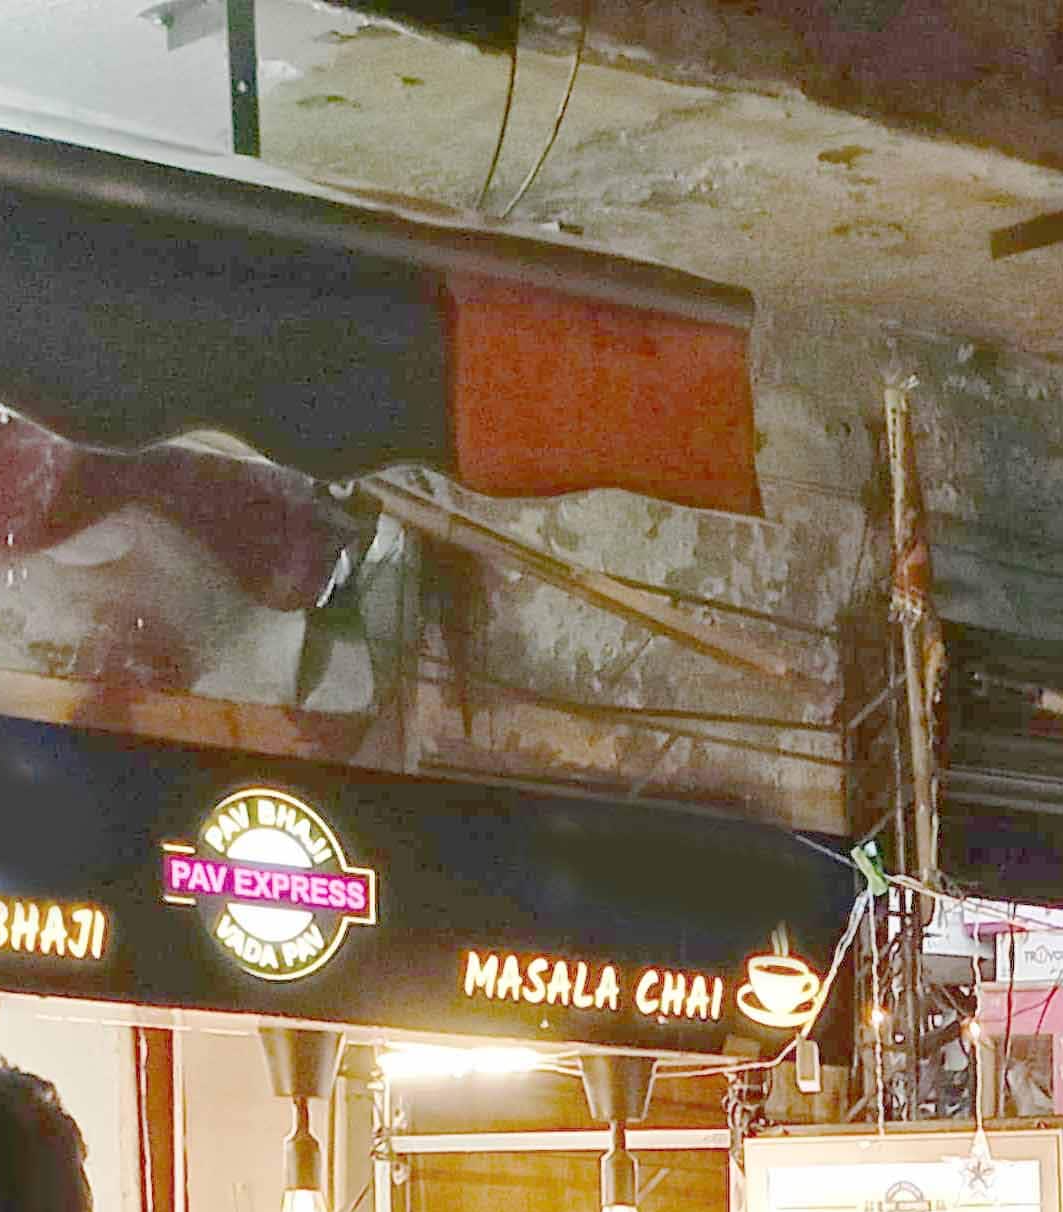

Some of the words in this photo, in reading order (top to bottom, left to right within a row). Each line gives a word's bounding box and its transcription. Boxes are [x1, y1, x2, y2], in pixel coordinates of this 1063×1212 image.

[204, 801, 249, 852] PAV
[257, 799, 332, 864] BHAJI
[171, 859, 227, 892] PAV
[233, 867, 366, 910] EXPRESS
[216, 915, 279, 968] VADA
[281, 923, 326, 967] PAV
[465, 951, 619, 1010] MASALA
[636, 970, 724, 1020] CHAI
